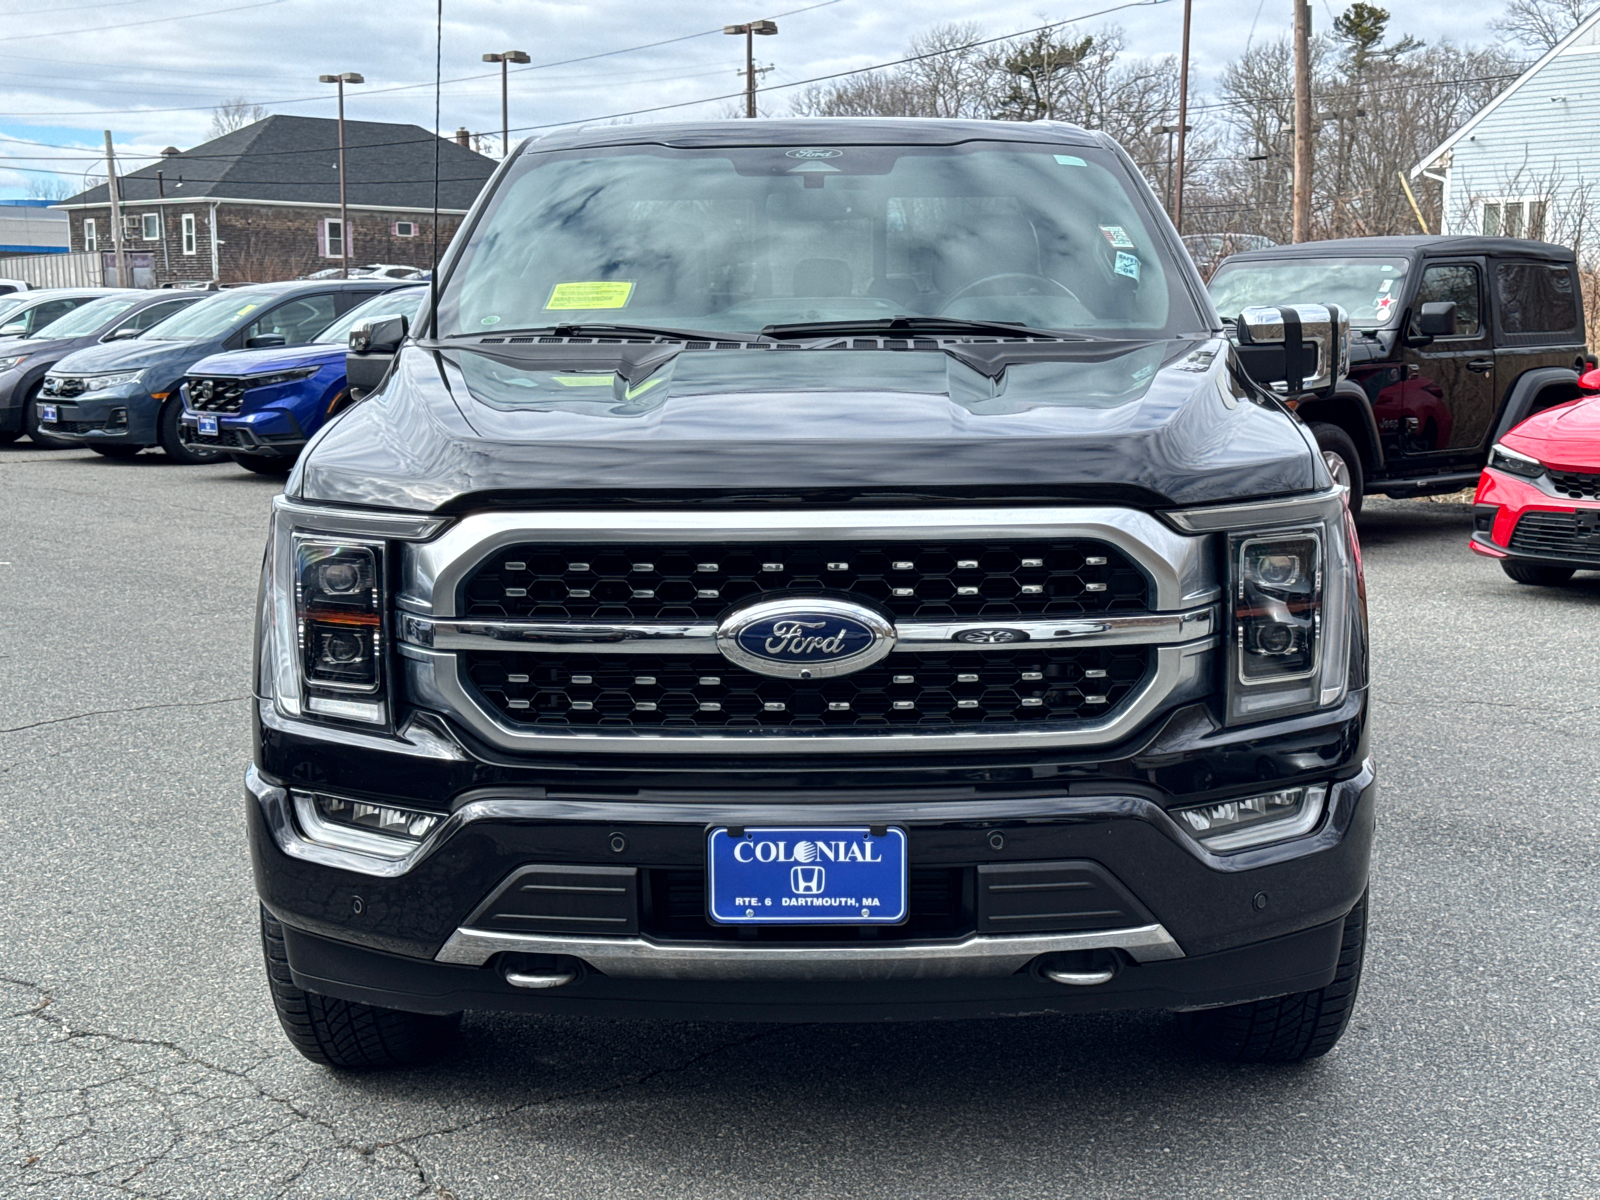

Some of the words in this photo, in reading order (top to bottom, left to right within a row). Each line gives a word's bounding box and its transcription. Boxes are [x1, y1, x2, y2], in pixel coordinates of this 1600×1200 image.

[796, 149, 832, 157] Ford
[1123, 267, 1134, 275] OK
[1379, 418, 1399, 430] Jeep
[765, 620, 847, 654] Ford
[733, 840, 882, 863] COLONIAL
[735, 897, 761, 906] RTE.
[764, 897, 772, 906] 6
[781, 897, 859, 908] DARTMOUTH,
[862, 897, 880, 906] MA
